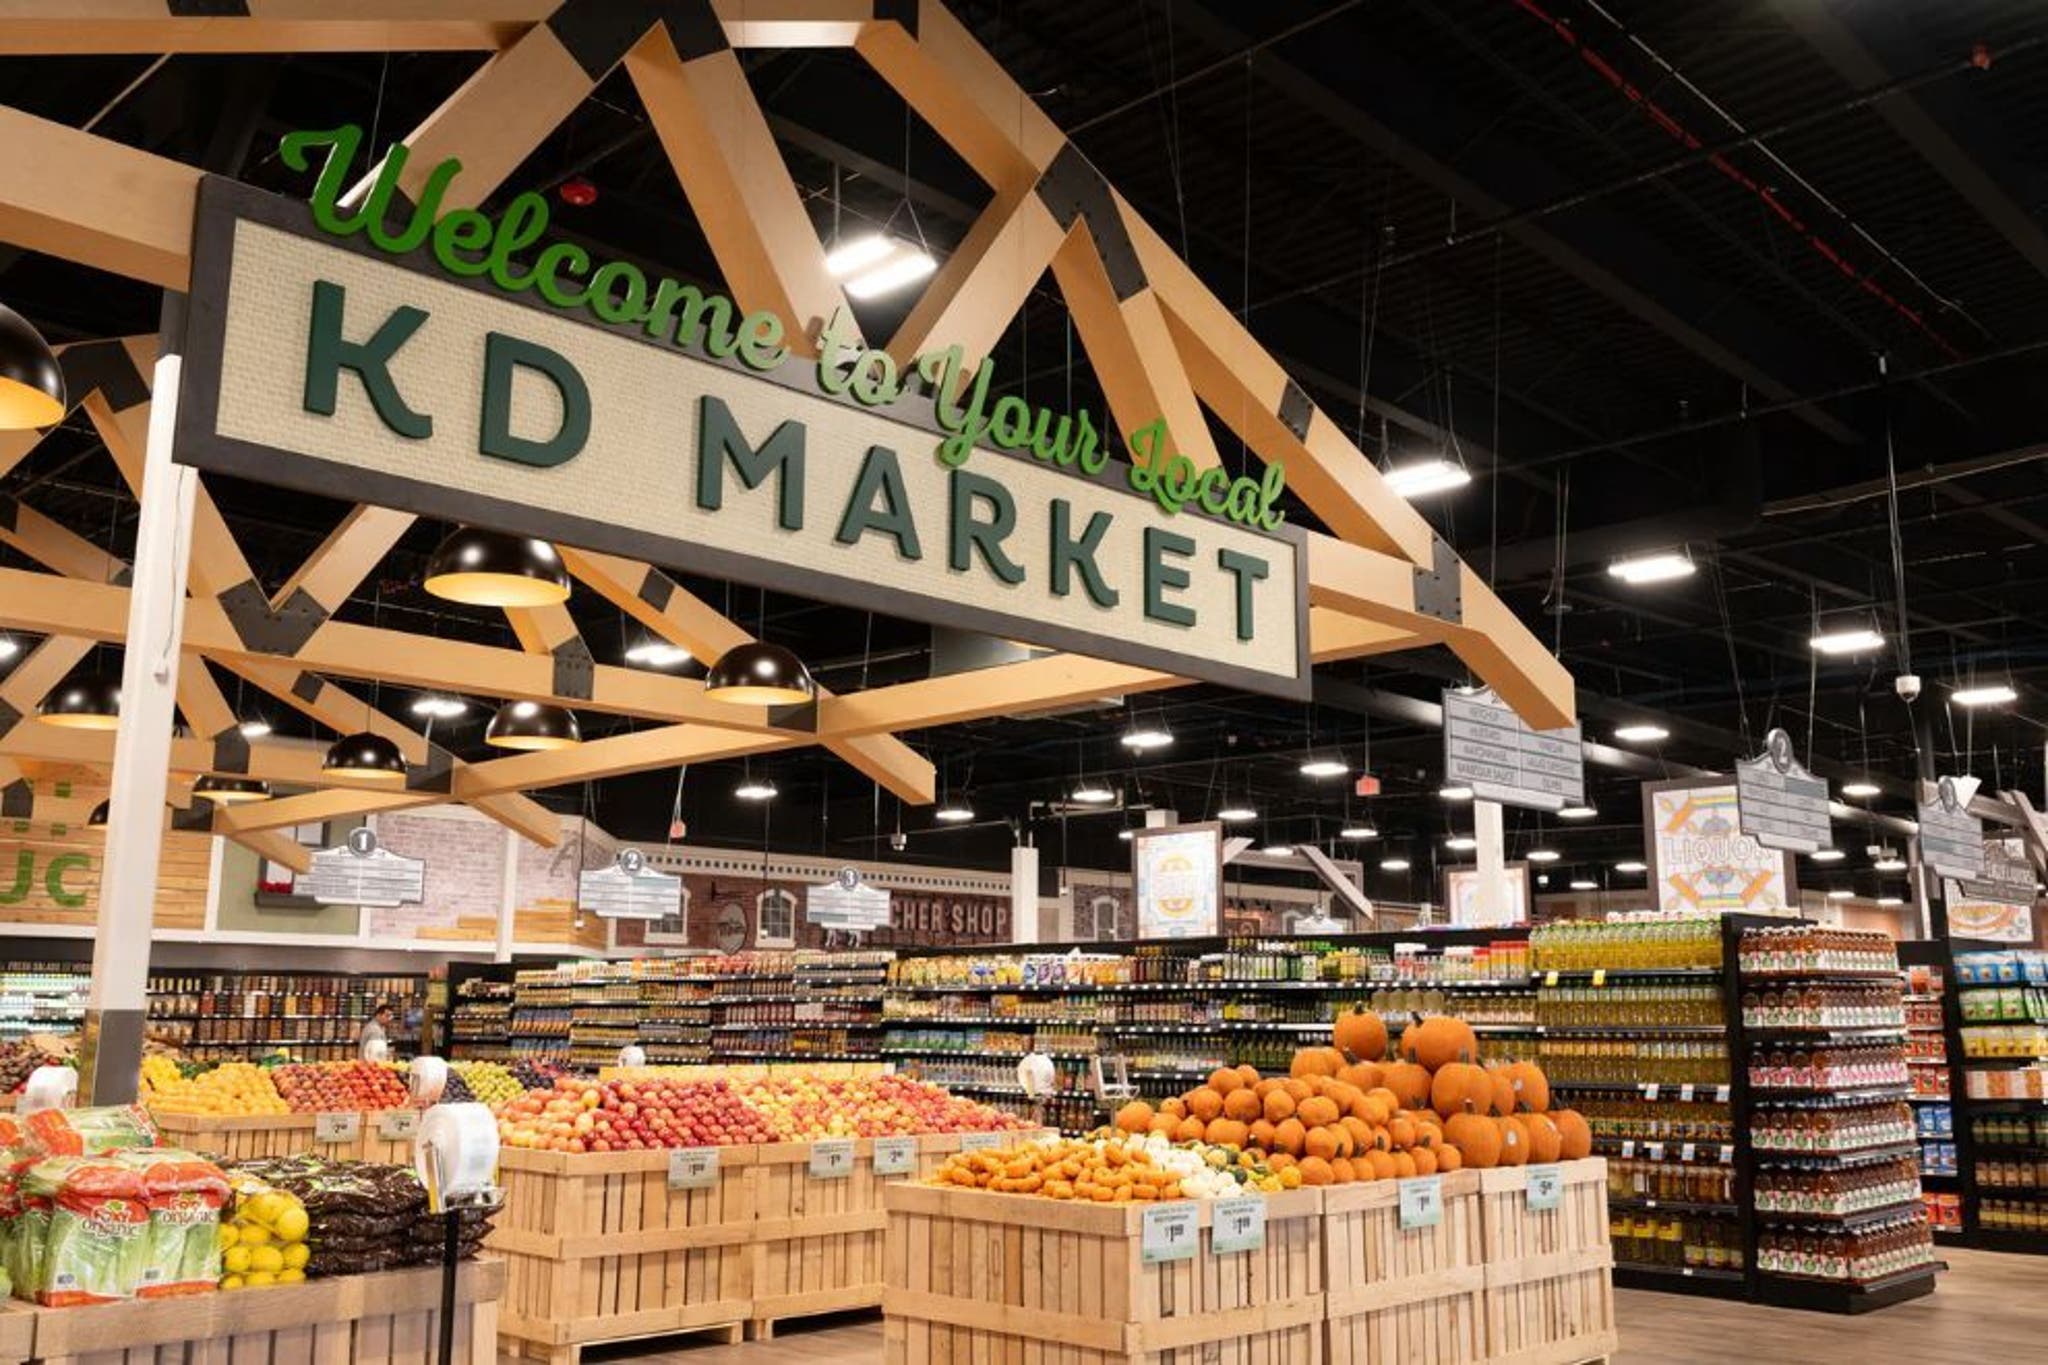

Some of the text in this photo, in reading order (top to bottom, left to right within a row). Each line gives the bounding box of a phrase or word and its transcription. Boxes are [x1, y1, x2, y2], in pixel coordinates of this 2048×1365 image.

[280, 124, 1287, 530] Welcome to Your Local
[303, 279, 1270, 642] KD MARKET
[952, 903, 1008, 935] SHOP
